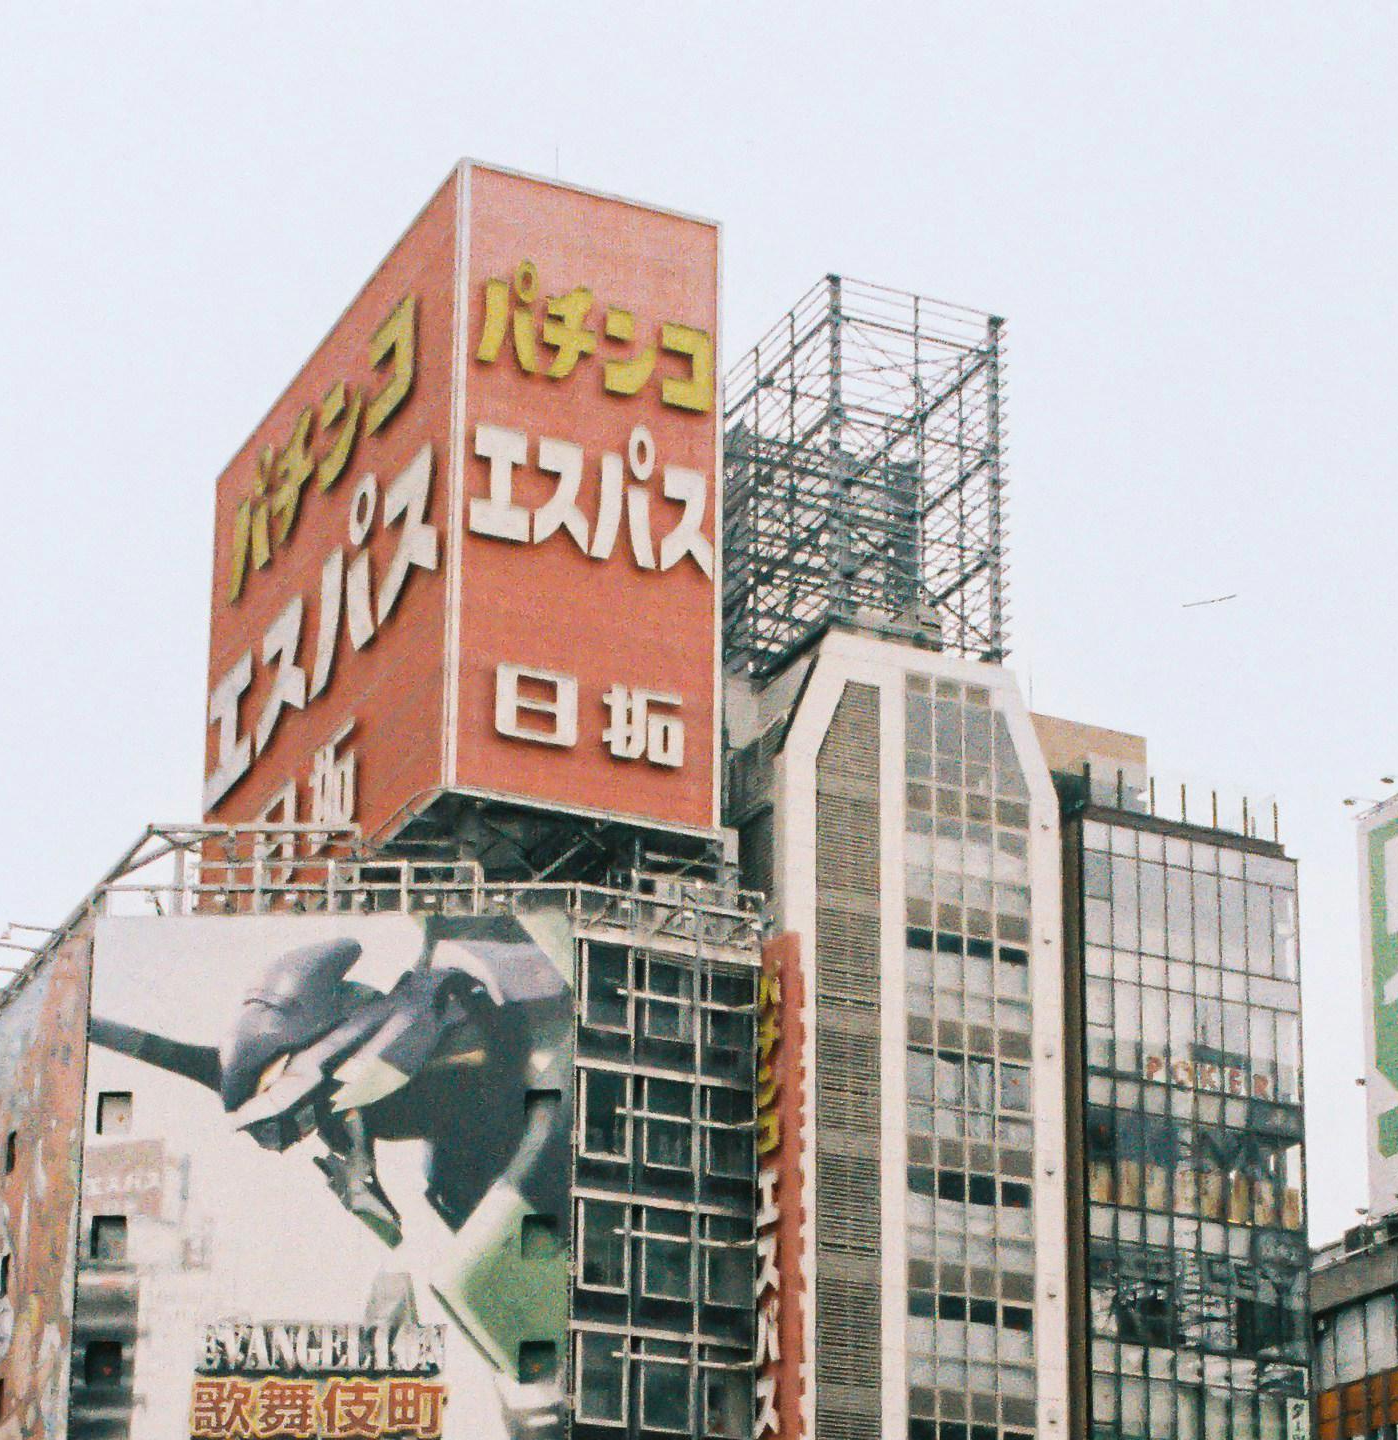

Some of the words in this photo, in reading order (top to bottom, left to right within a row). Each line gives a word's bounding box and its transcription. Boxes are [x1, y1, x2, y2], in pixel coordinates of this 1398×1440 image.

[476, 259, 714, 412] パチンコ
[228, 294, 421, 602] パチンコ
[469, 424, 714, 579] エスパス
[205, 442, 441, 815] エスパス
[495, 661, 684, 768] 日拓
[1146, 1056, 1272, 1097] POKER
[756, 1170, 782, 1440] エスパス
[192, 1378, 446, 1438] 歌舞伎町
